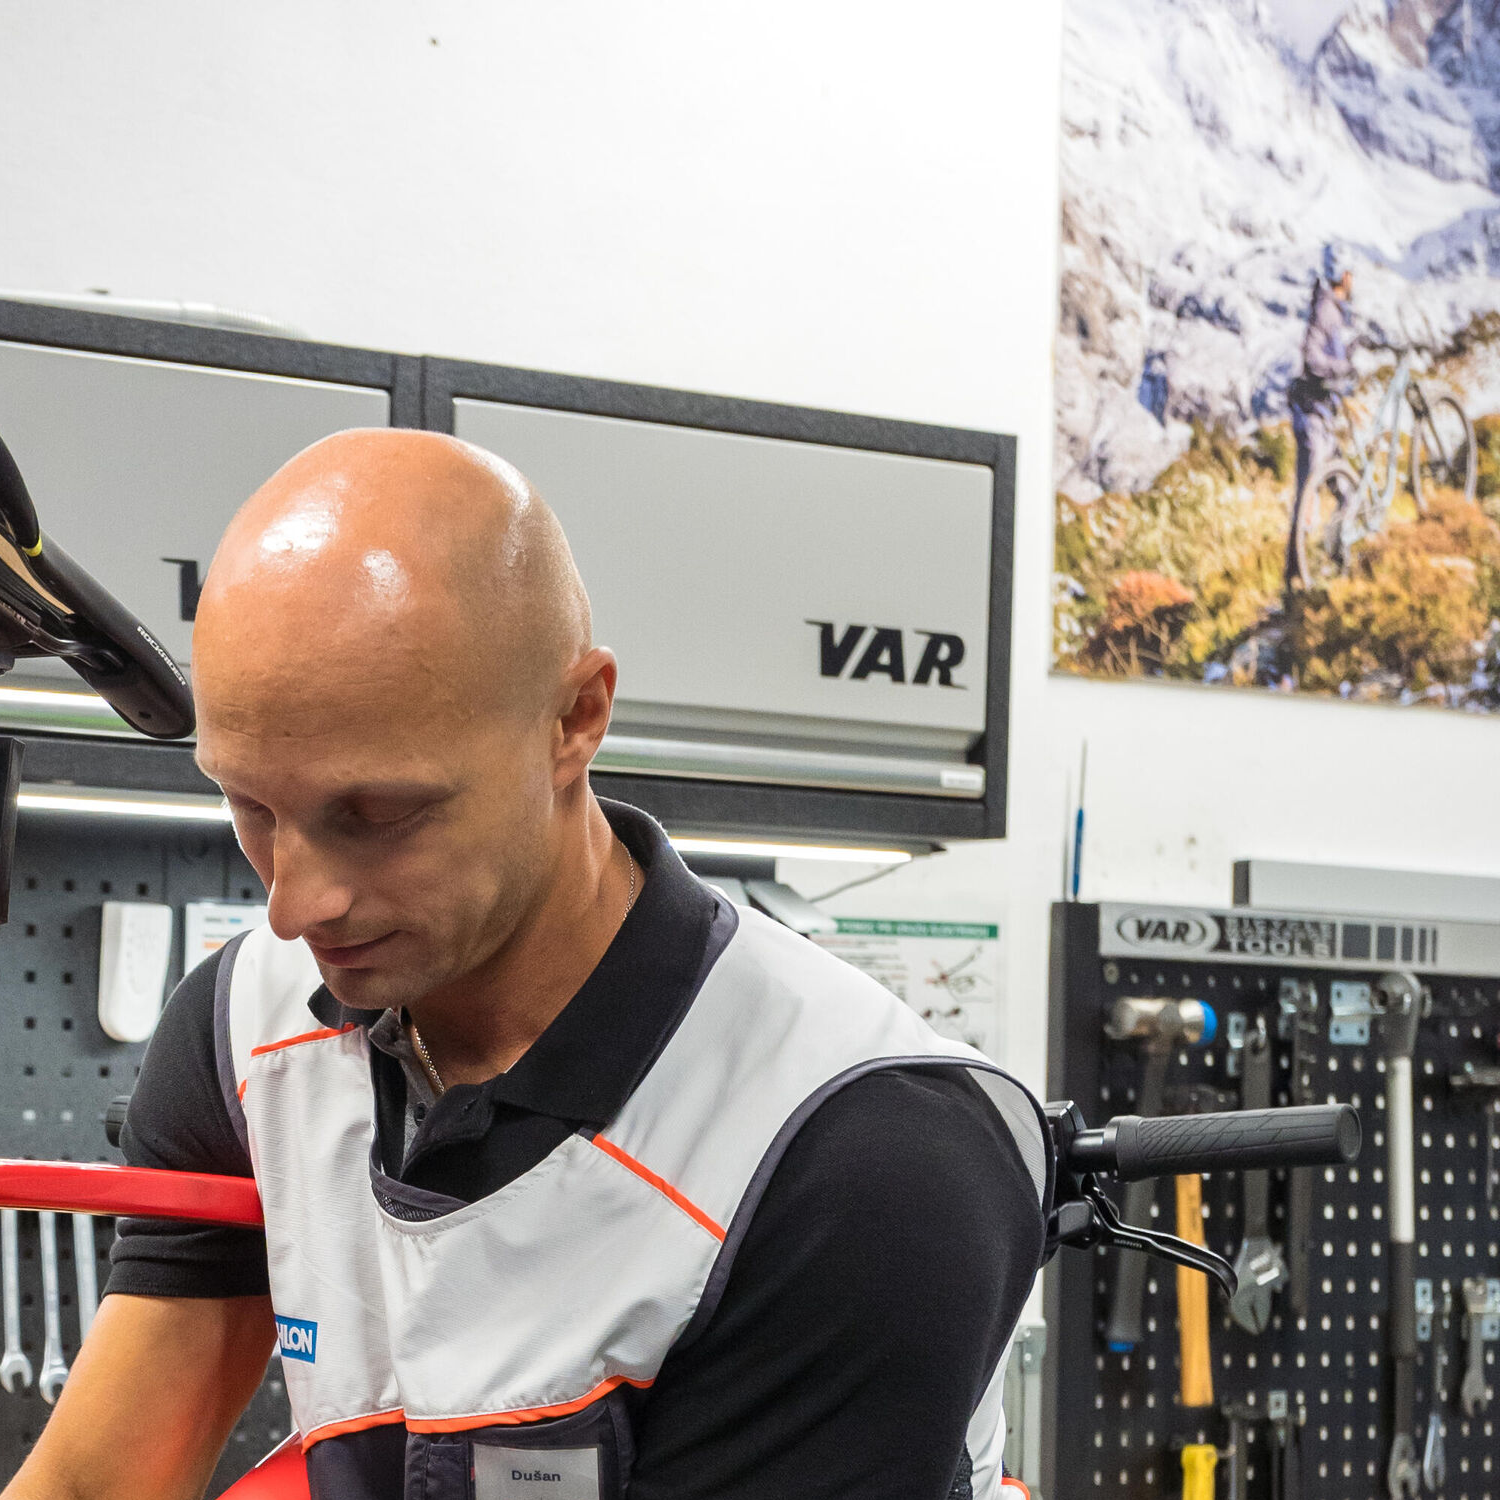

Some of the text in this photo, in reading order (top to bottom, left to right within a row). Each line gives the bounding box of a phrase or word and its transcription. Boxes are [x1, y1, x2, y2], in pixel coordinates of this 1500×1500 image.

[137, 626, 186, 686] ROCKRIDER
[804, 620, 968, 690] VAR
[1135, 919, 1191, 943] VAR
[1229, 938, 1331, 958] TOOLS
[512, 1470, 561, 1482] Dušan
